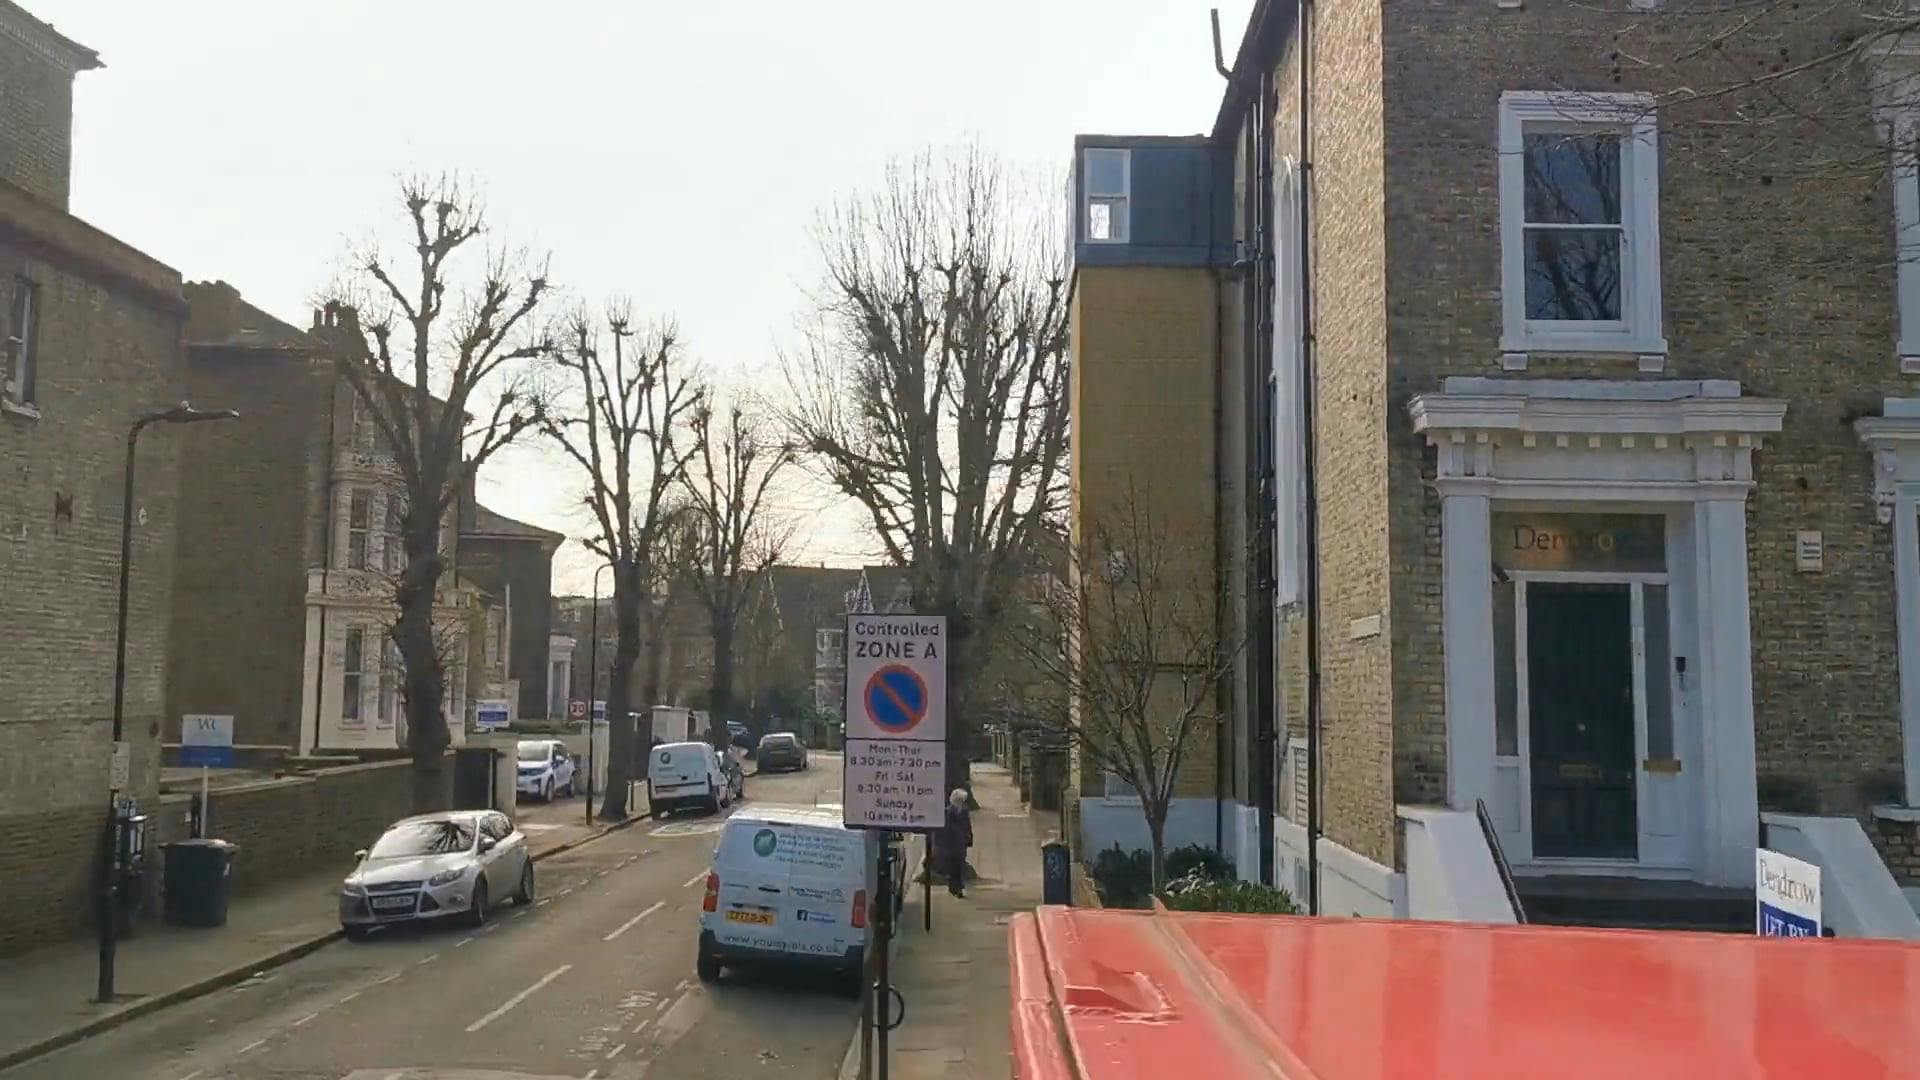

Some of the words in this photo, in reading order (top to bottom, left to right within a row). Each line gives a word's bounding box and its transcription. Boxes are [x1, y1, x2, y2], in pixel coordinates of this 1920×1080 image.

[855, 621, 939, 637] Controlled
[855, 641, 916, 658] ZONE
[923, 642, 938, 659] A
[874, 798, 915, 810] Sunday
